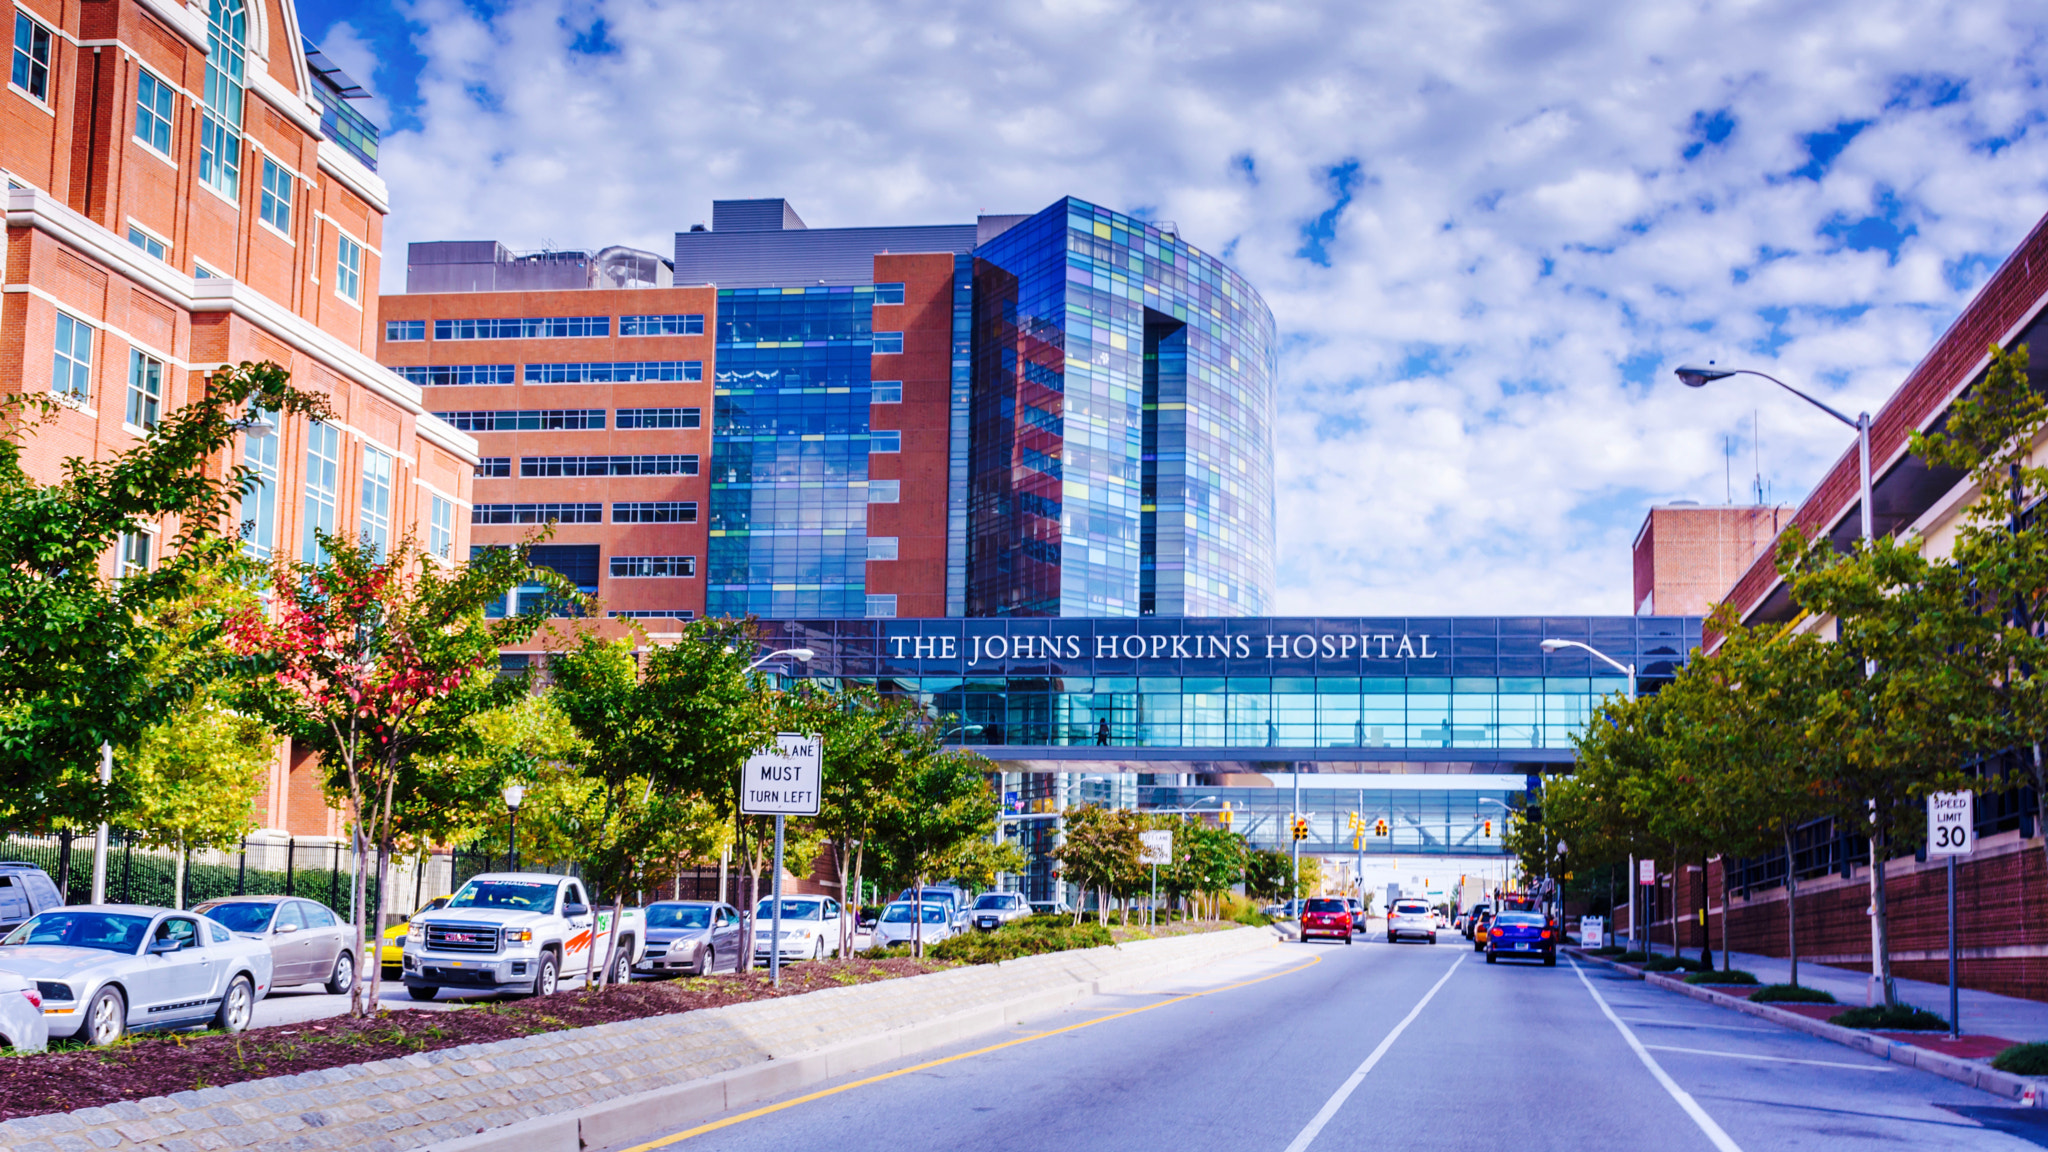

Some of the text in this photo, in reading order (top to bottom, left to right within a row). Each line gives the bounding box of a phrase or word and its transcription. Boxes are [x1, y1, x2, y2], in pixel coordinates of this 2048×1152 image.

[890, 634, 1437, 666] THE JOHNS HOPKINS HOSPITAL
[784, 745, 815, 757] LANE
[761, 766, 802, 782] MUST
[750, 790, 812, 804] TURN LEFT
[1934, 799, 1967, 809] SPEED
[1937, 812, 1962, 823] LIMIT
[1936, 825, 1966, 848] 30
